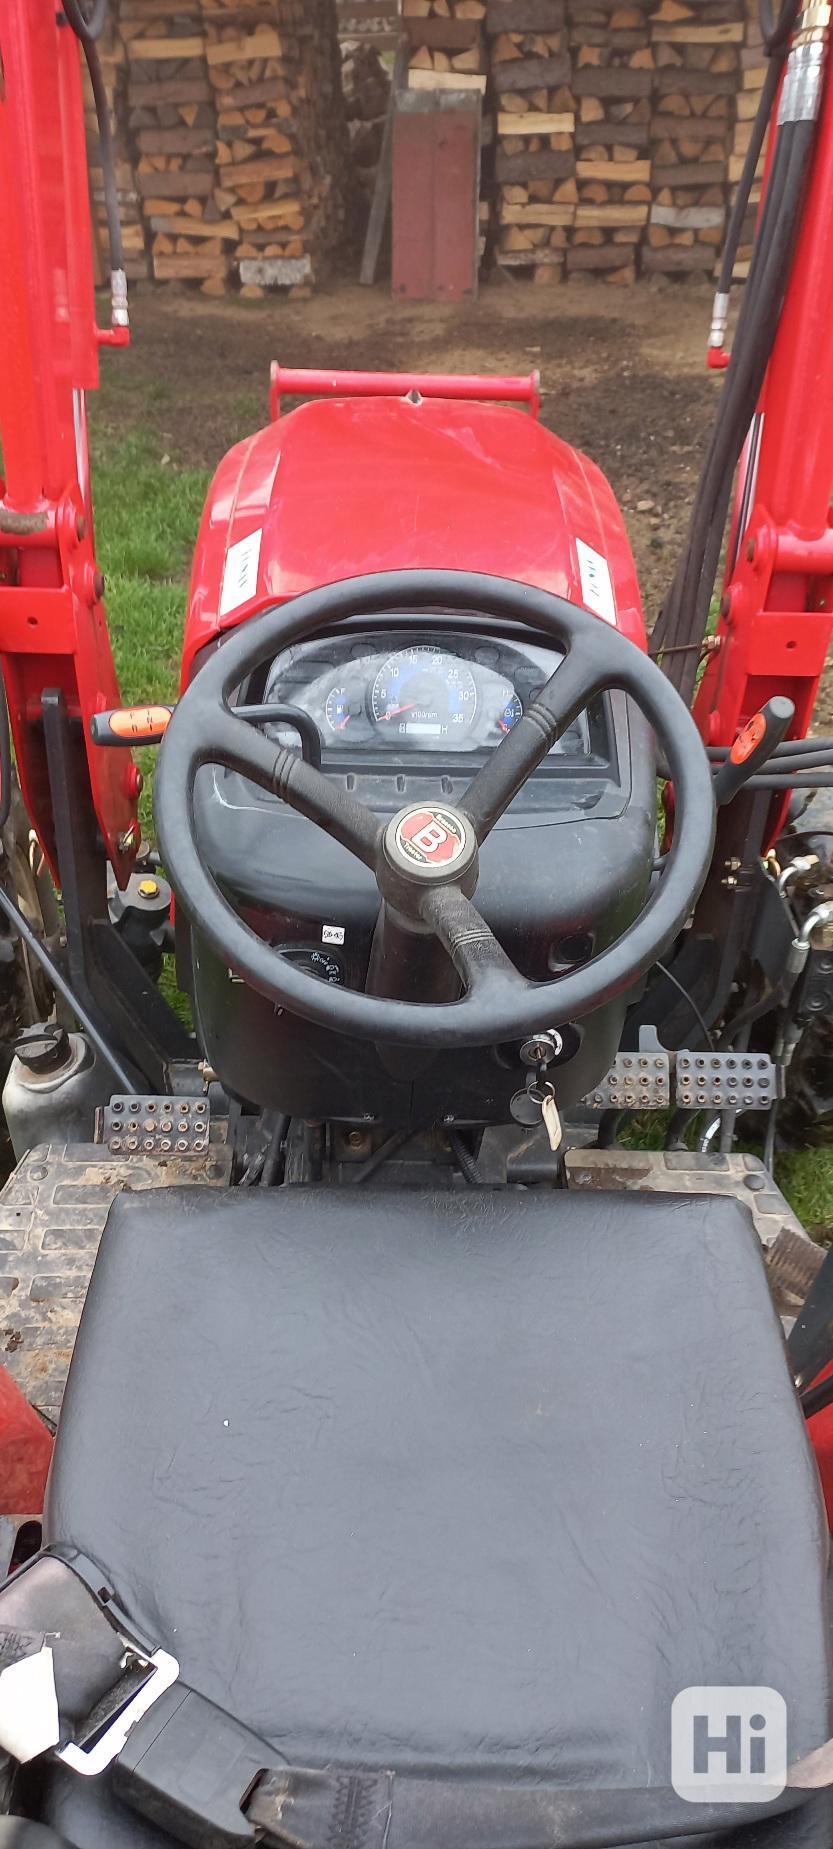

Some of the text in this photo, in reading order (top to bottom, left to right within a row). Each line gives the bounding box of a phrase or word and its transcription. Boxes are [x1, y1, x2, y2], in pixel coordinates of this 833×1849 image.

[409, 655, 418, 664] 15
[431, 655, 442, 665] 20
[390, 667, 399, 677] 10
[447, 669, 459, 679] 25
[452, 713, 464, 723] 35
[411, 819, 448, 853] B
